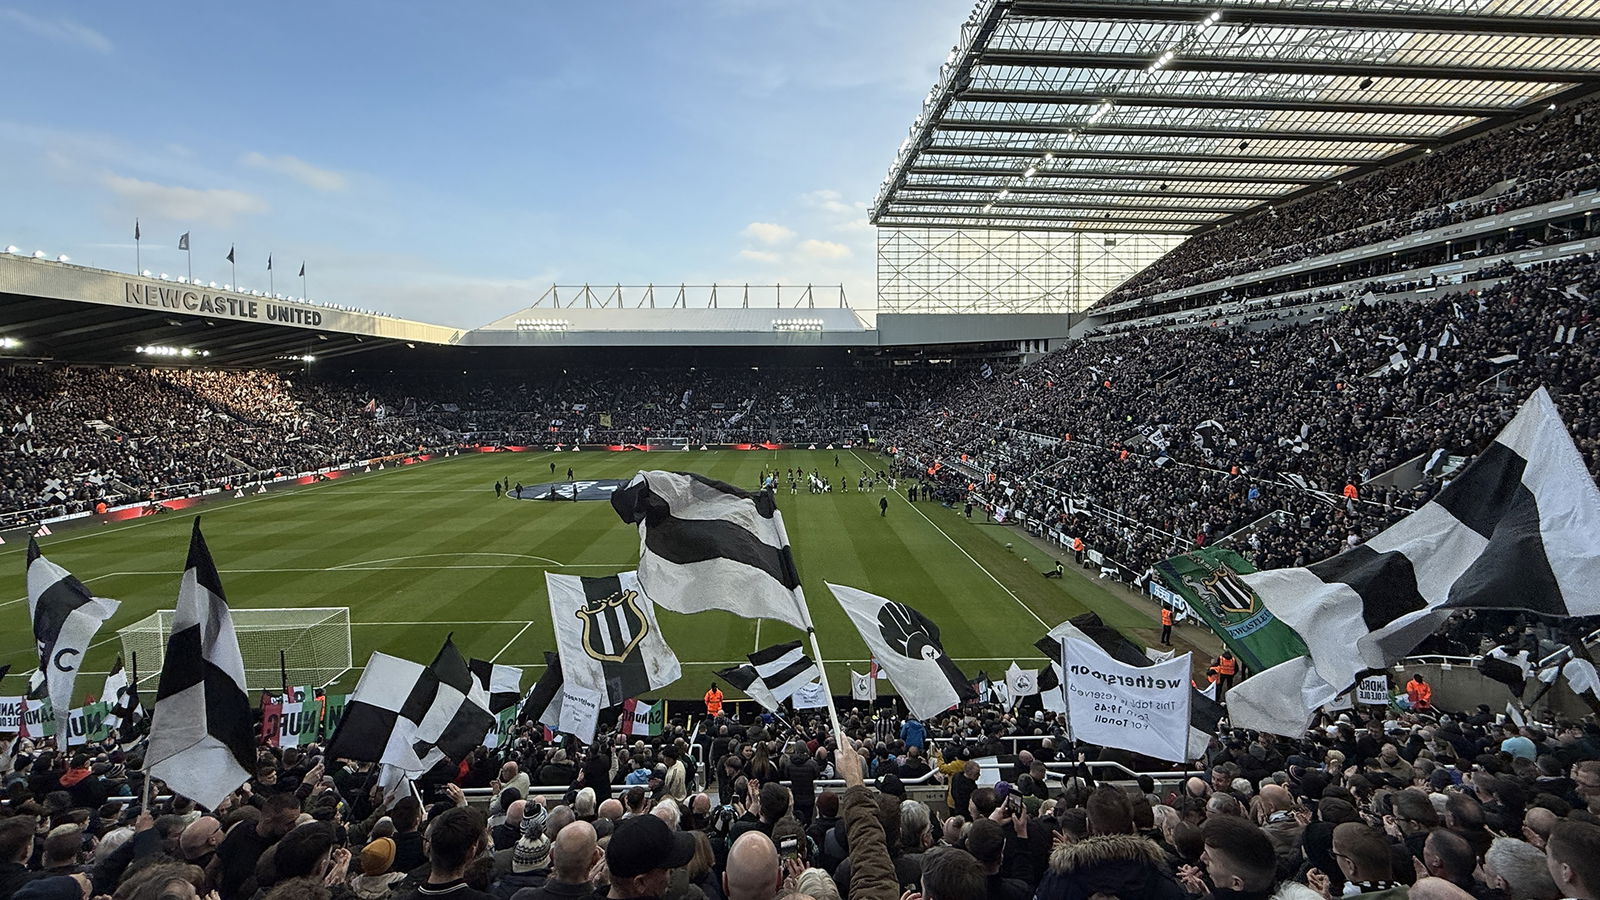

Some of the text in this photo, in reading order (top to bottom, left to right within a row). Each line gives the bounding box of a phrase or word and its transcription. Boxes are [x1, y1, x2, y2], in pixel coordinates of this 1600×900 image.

[125, 282, 322, 326] NEWCASTLE UNITED
[1229, 613, 1267, 637] EWCASTLE
[53, 647, 80, 672] C
